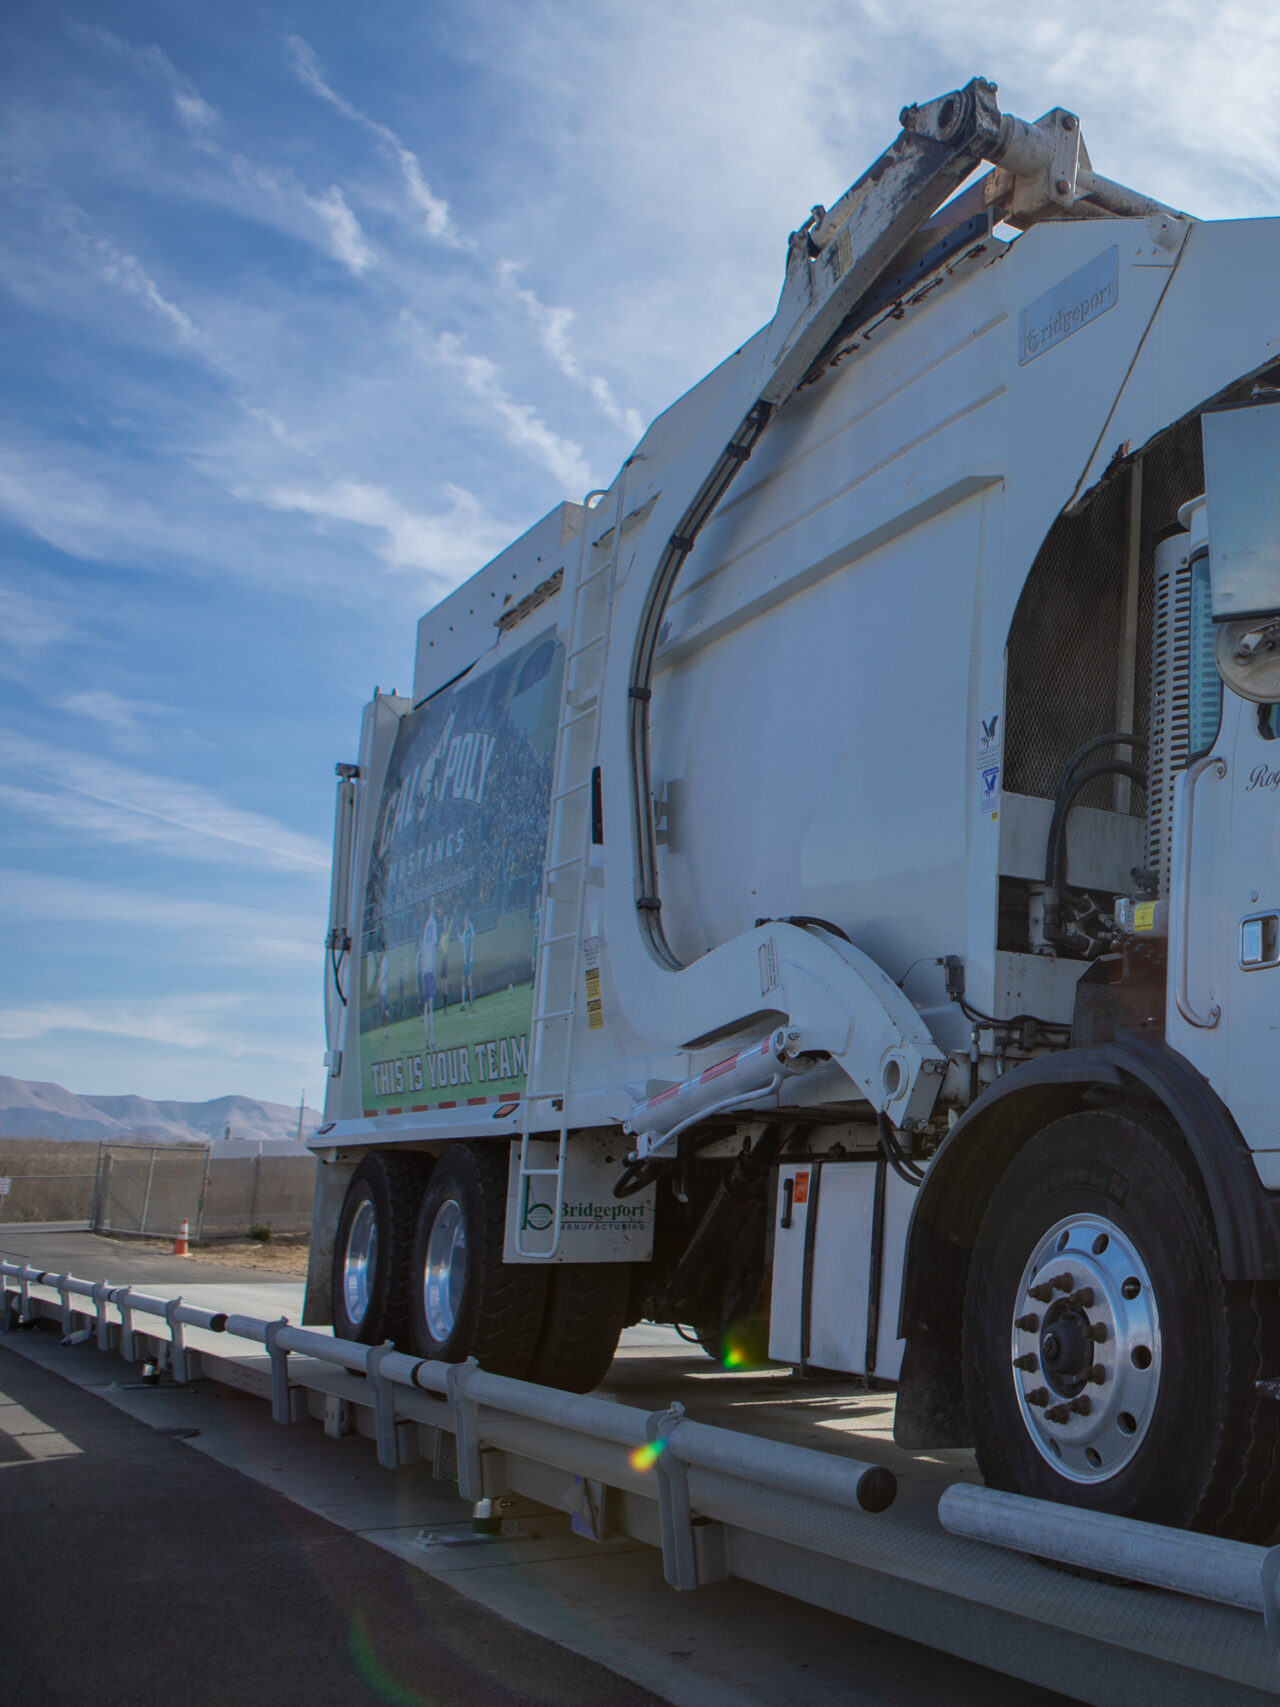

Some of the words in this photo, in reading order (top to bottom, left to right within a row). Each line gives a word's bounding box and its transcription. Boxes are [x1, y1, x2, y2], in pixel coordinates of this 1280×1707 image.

[437, 732, 497, 805] POLY
[387, 828, 465, 884] MUSTANGS
[371, 1058, 404, 1097] THIS
[407, 1055, 424, 1093] IS
[426, 1045, 473, 1090] YOUR
[474, 1034, 529, 1084] TEAM
